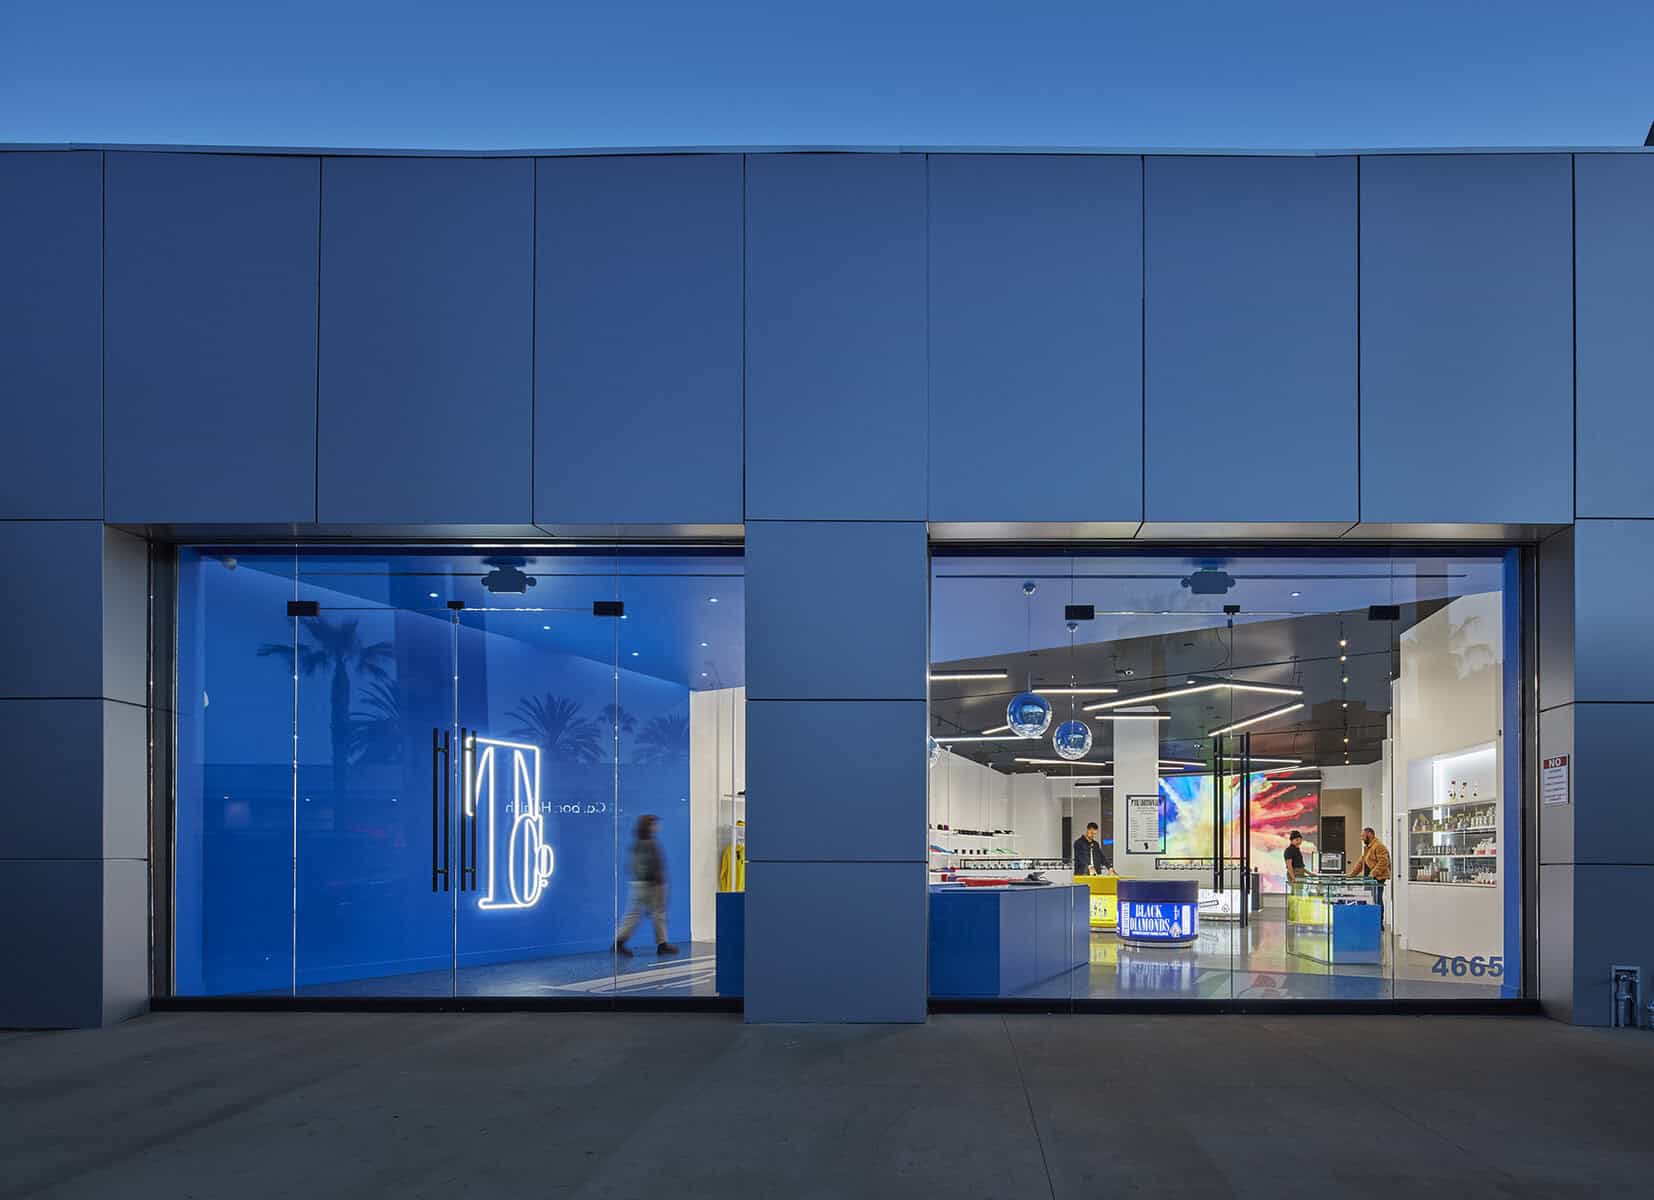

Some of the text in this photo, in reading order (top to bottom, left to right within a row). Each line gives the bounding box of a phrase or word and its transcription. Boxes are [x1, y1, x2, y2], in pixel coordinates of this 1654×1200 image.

[1549, 757, 1561, 768] NO
[1135, 904, 1162, 918] BLACK
[1130, 917, 1170, 931] DIAMONDS
[1431, 955, 1504, 977] 4665
